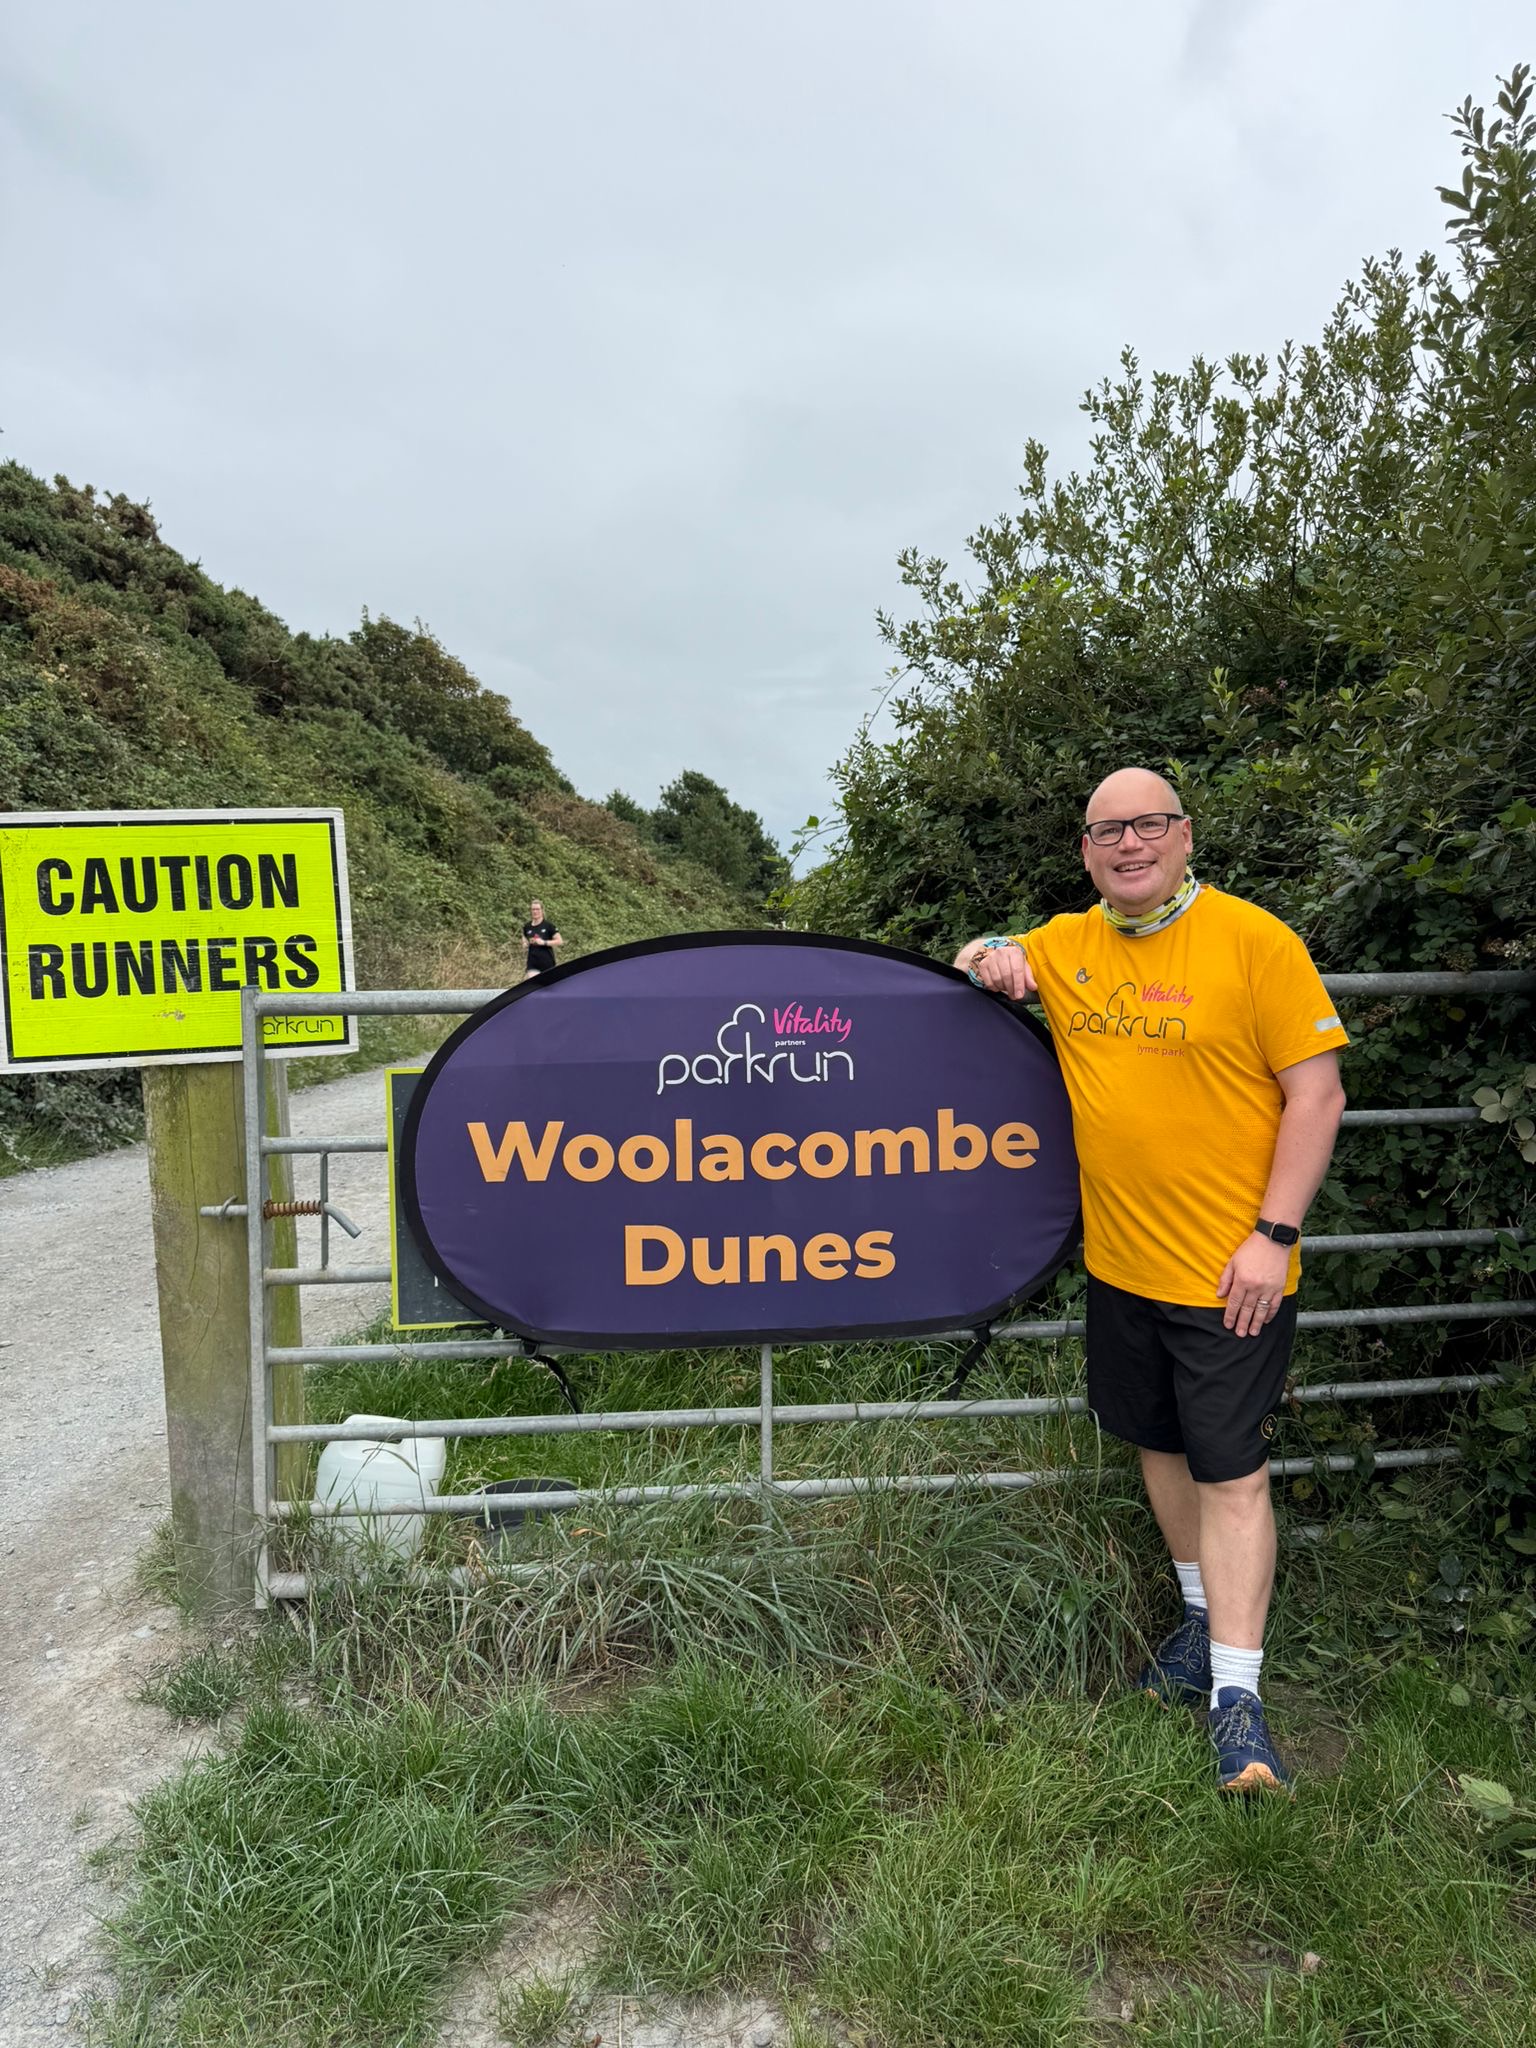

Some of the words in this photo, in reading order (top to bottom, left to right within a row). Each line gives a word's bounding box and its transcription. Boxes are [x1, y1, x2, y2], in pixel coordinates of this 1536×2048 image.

[36, 853, 300, 916] CAUTION
[28, 934, 320, 1000] RUNNERS
[1141, 979, 1194, 1010] Vitality
[262, 1015, 334, 1036] arkrun
[773, 1001, 853, 1043] Vitality
[1067, 1000, 1187, 1041] parkrun
[656, 1031, 855, 1095] parkrun
[774, 1038, 806, 1048] partners
[1137, 1043, 1159, 1056] lyme
[1161, 1048, 1185, 1058] park
[466, 1108, 1041, 1183] Woolacombe
[624, 1224, 897, 1286] Dunes
